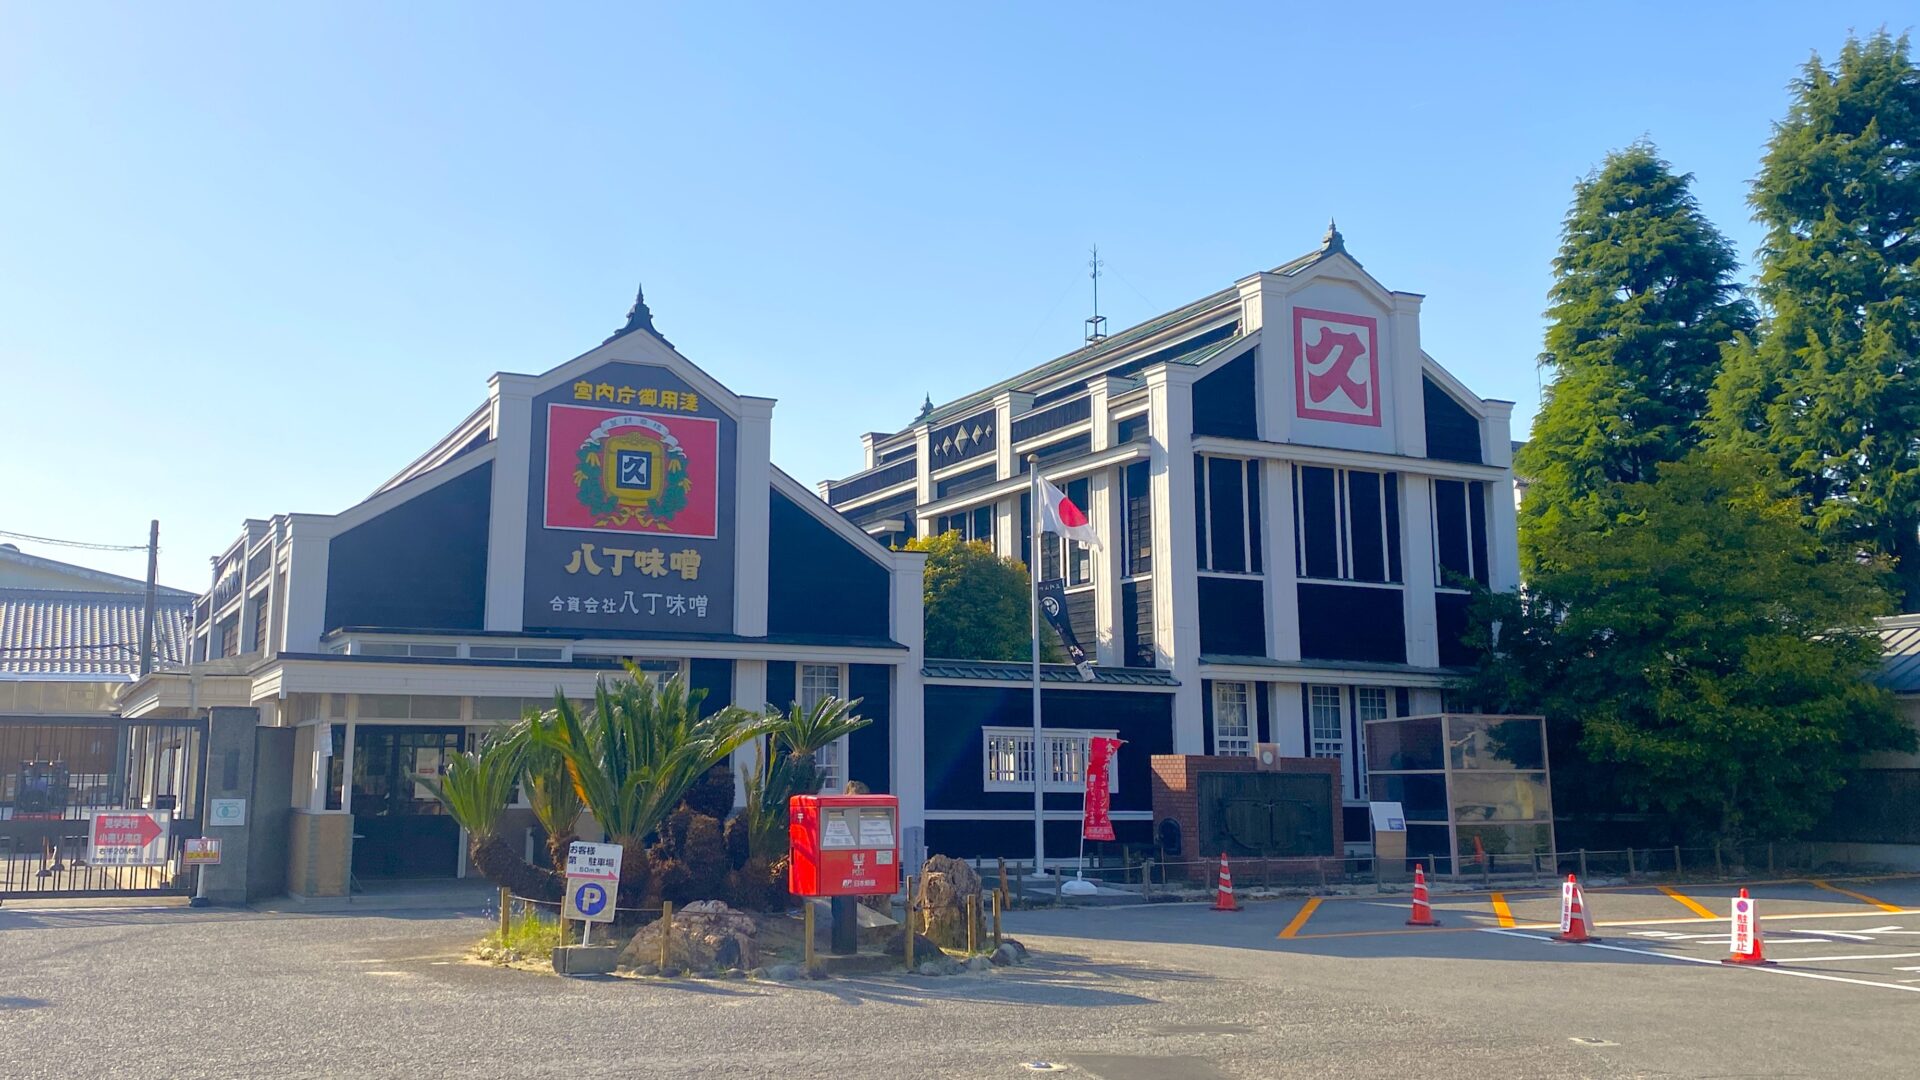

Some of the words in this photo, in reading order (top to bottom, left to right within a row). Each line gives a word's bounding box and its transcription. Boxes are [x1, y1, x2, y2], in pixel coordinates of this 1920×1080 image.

[573, 380, 700, 413] 宮内庁御用達
[564, 543, 702, 580] 八丁味噌
[549, 590, 709, 617] 合資会社八丁味噌
[105, 818, 139, 828] 見学受付
[99, 833, 143, 844] 小売り売店
[569, 845, 596, 855] お客様
[589, 857, 614, 867] 駐車場
[582, 887, 602, 911] P
[1735, 913, 1748, 952] 駐車禁止
